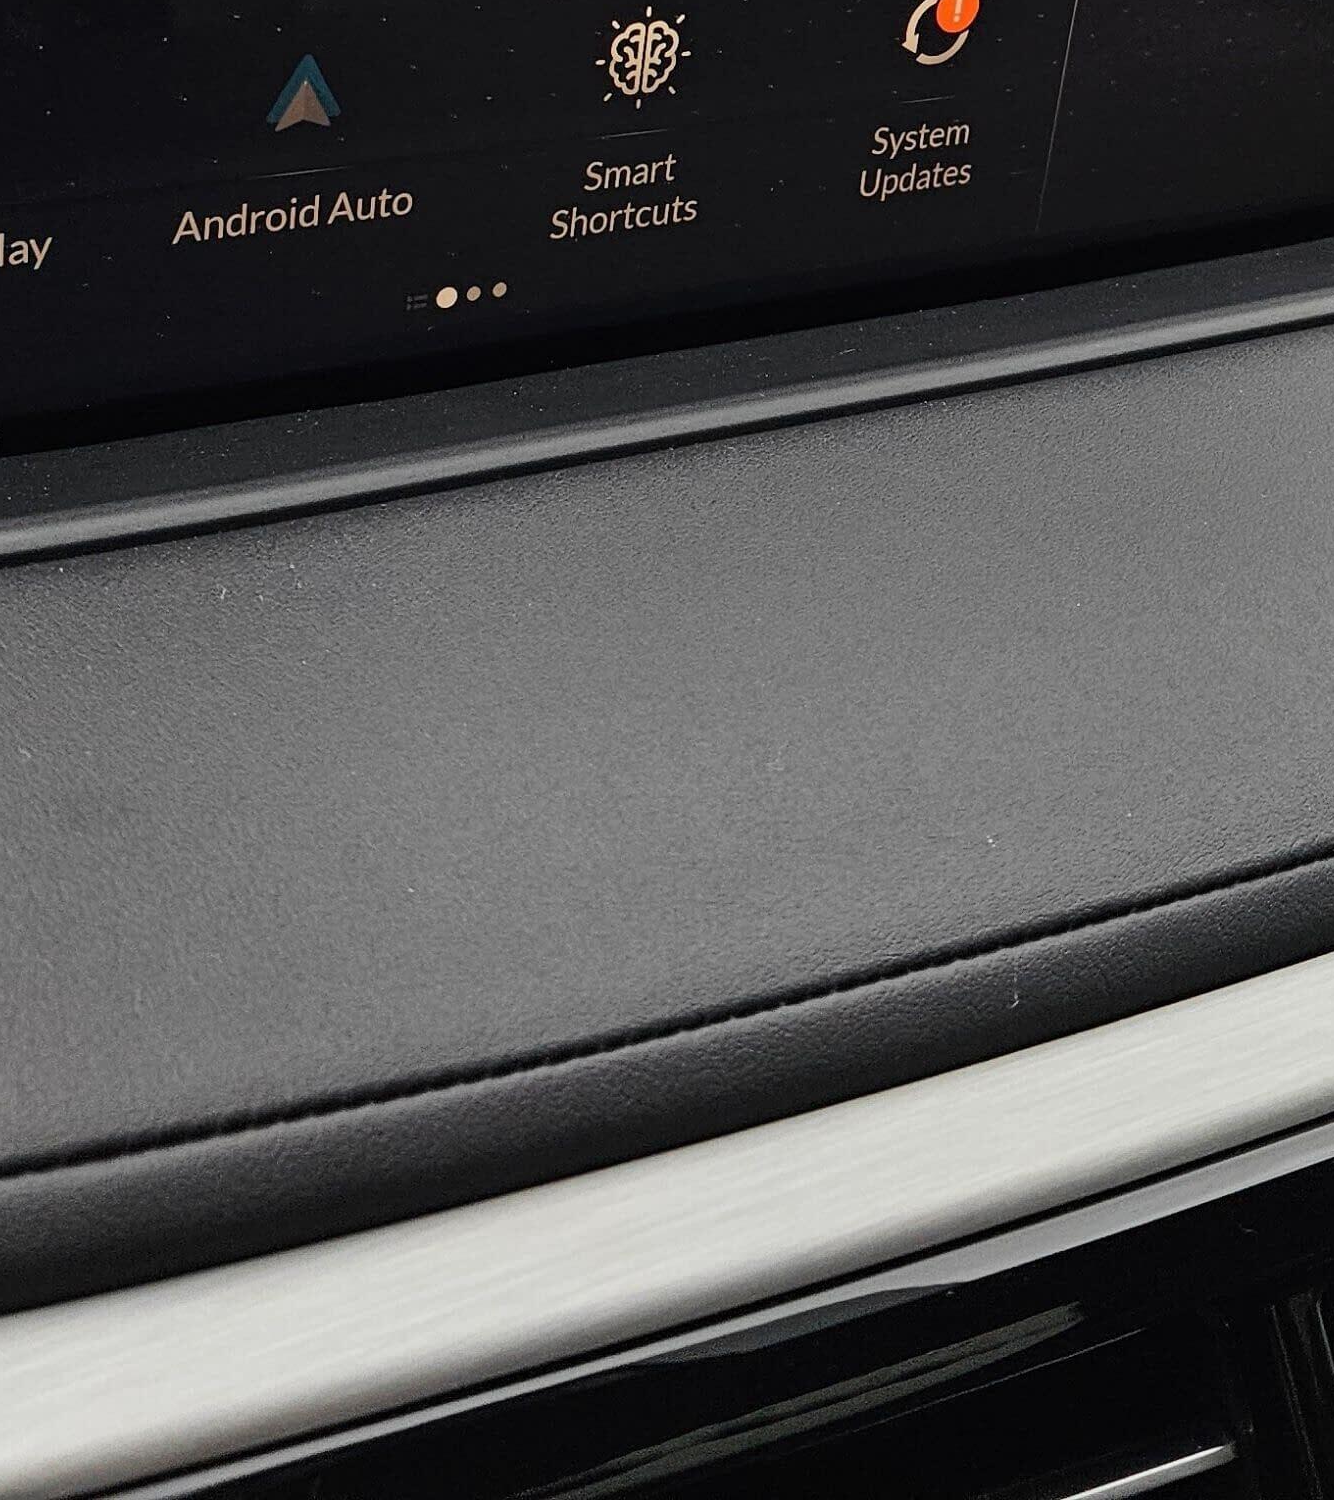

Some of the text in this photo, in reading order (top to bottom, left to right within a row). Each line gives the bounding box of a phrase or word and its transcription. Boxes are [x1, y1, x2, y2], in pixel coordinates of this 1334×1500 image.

[872, 124, 969, 159] System
[584, 154, 676, 190] Smart
[860, 163, 971, 201] Updates
[173, 188, 412, 244] Android Auto
[550, 196, 697, 238] Shortcuts
